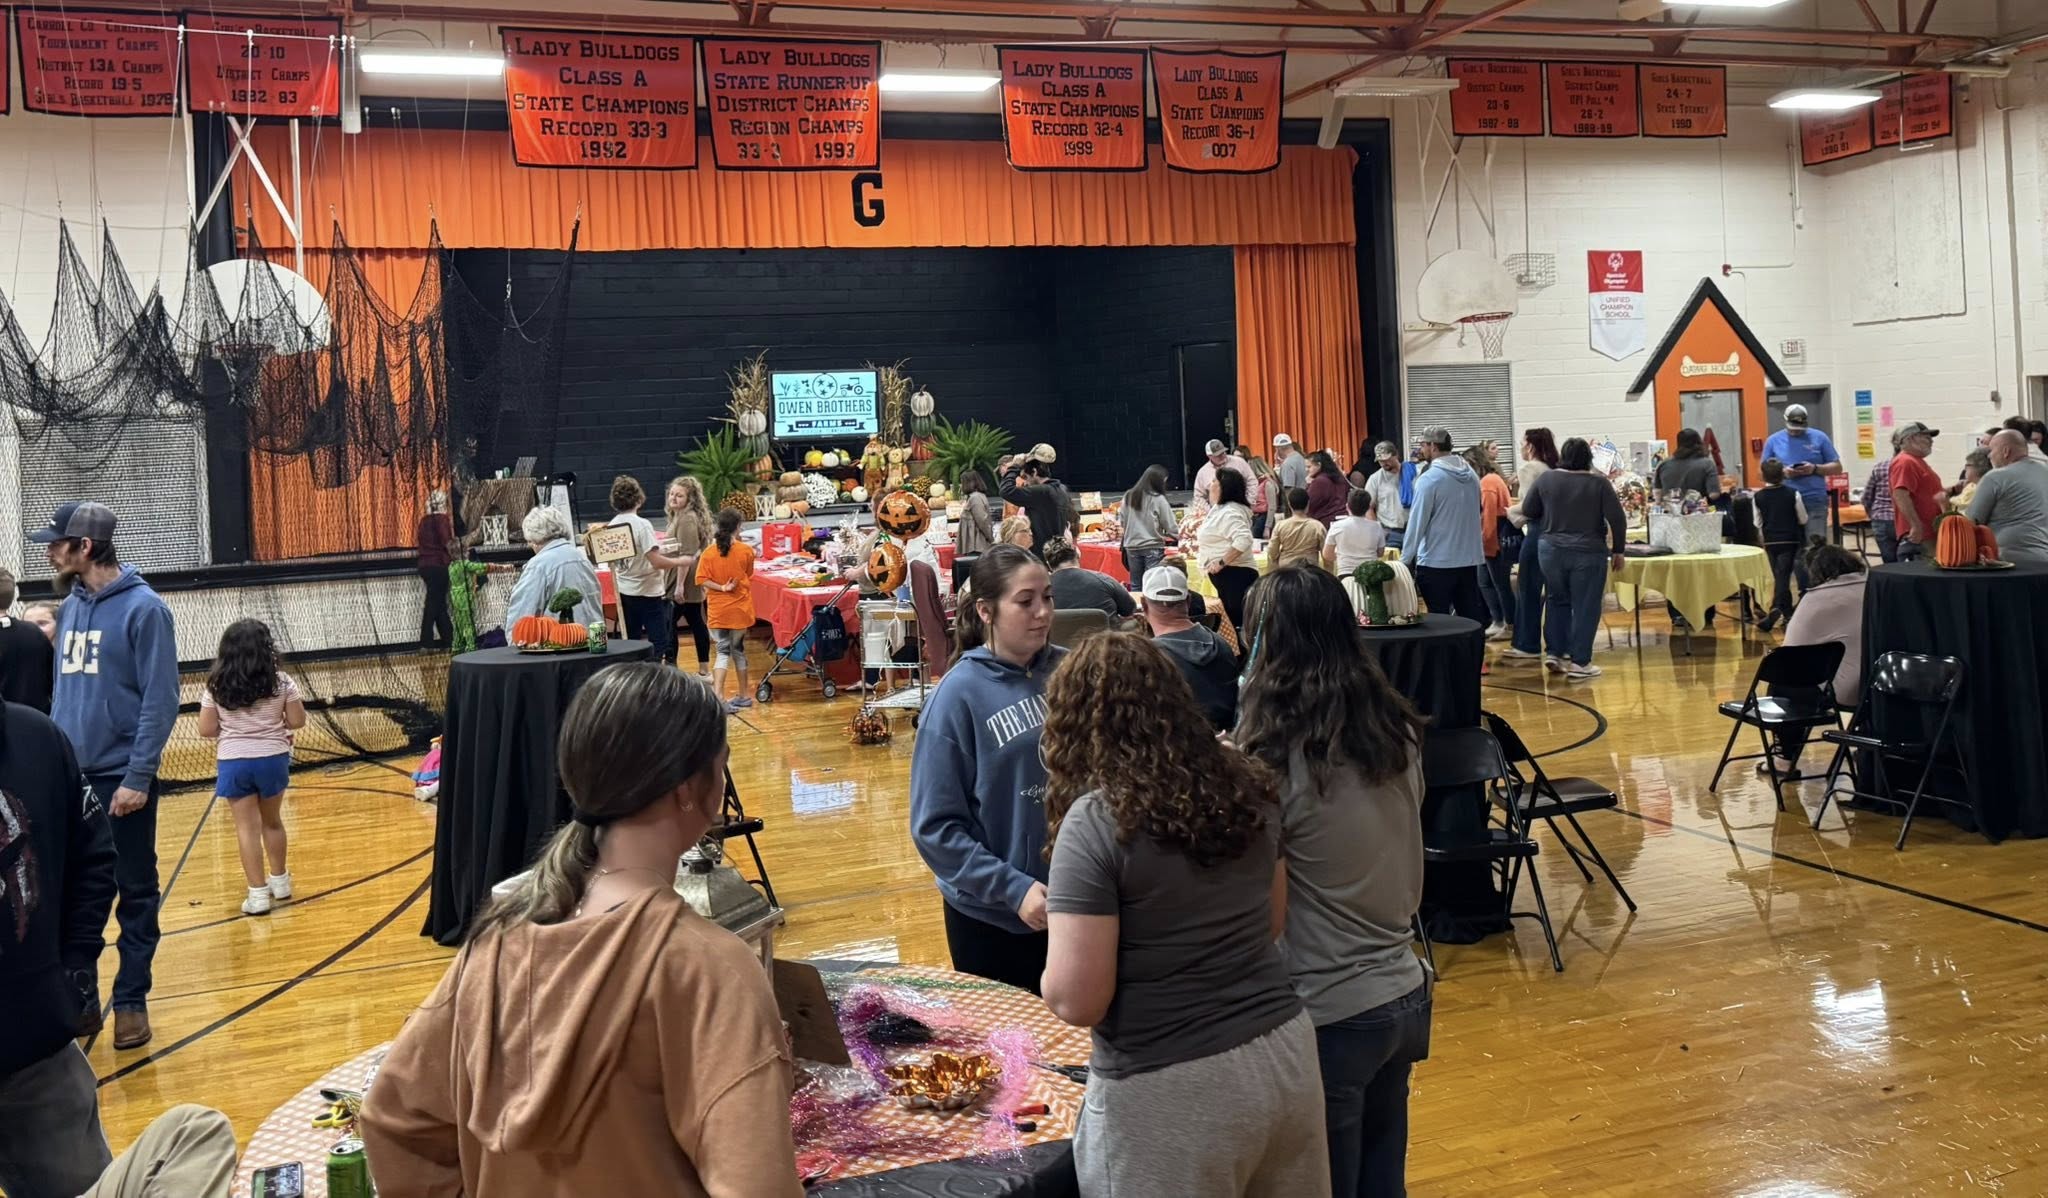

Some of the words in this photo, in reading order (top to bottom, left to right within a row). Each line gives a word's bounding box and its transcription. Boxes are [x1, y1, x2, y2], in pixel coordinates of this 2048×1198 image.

[39, 35, 108, 50] TOURNAMENT
[117, 38, 159, 51] CHAMPS
[514, 37, 571, 57] LADY
[579, 40, 680, 61] BULLDOGS
[37, 57, 83, 71] DISTRICT
[90, 58, 115, 72] 13A
[123, 60, 164, 74] CHAMPS
[720, 48, 770, 65] LADY
[784, 49, 870, 68] BULLDOGS
[217, 65, 262, 81] DISTRICT
[272, 68, 310, 81] CHAMPS
[560, 67, 622, 86] CLASS
[633, 70, 648, 87] A
[1013, 61, 1055, 77] LADY
[1059, 62, 1133, 80] BULLDOGS
[1174, 67, 1203, 82] LADY
[1209, 66, 1258, 83] BULLDOGS
[1488, 63, 1528, 74] BASKETBALL
[1583, 66, 1621, 77] BASKETBALL
[64, 77, 103, 90] RECORD
[715, 73, 770, 90] STATE
[777, 74, 870, 91] RUNNER-UP
[1467, 83, 1496, 92] DISTRICT
[1499, 82, 1525, 93] CHAMPS
[1565, 80, 1593, 90] DISTRICT
[1594, 80, 1619, 92] CHAMPS
[1671, 73, 1712, 85] BASKETBALL
[278, 91, 297, 103] 83
[1042, 81, 1089, 98] CLASS
[1095, 82, 1106, 98] A
[1197, 85, 1228, 101] CLASS
[1235, 87, 1243, 101] A
[71, 93, 135, 107] BASKETBALL
[513, 93, 573, 111] STATE
[582, 94, 689, 115] CHAMPIONS
[717, 95, 797, 112] DISTRICT
[803, 96, 869, 112] CHAMPS
[1011, 100, 1056, 116] STATE
[1060, 101, 1139, 118] CHAMPIONS
[1171, 104, 1203, 121] STATE
[1210, 103, 1265, 120] CHAMPIONS
[540, 117, 618, 138] RECORD
[627, 121, 667, 139] 33-3
[729, 118, 790, 135] REGION
[798, 118, 864, 134] CHAMPS
[1032, 120, 1088, 136] RECORD
[1094, 122, 1123, 136] 32-4
[1182, 125, 1220, 140] RECORD
[1227, 124, 1255, 139] 36-1
[581, 141, 627, 159] 1992
[815, 142, 855, 159] 1993
[1064, 141, 1093, 156] 1999
[851, 173, 885, 227] G
[779, 401, 812, 415] OWEN
[817, 400, 872, 413] BROTHERS
[986, 705, 1027, 748] THE
